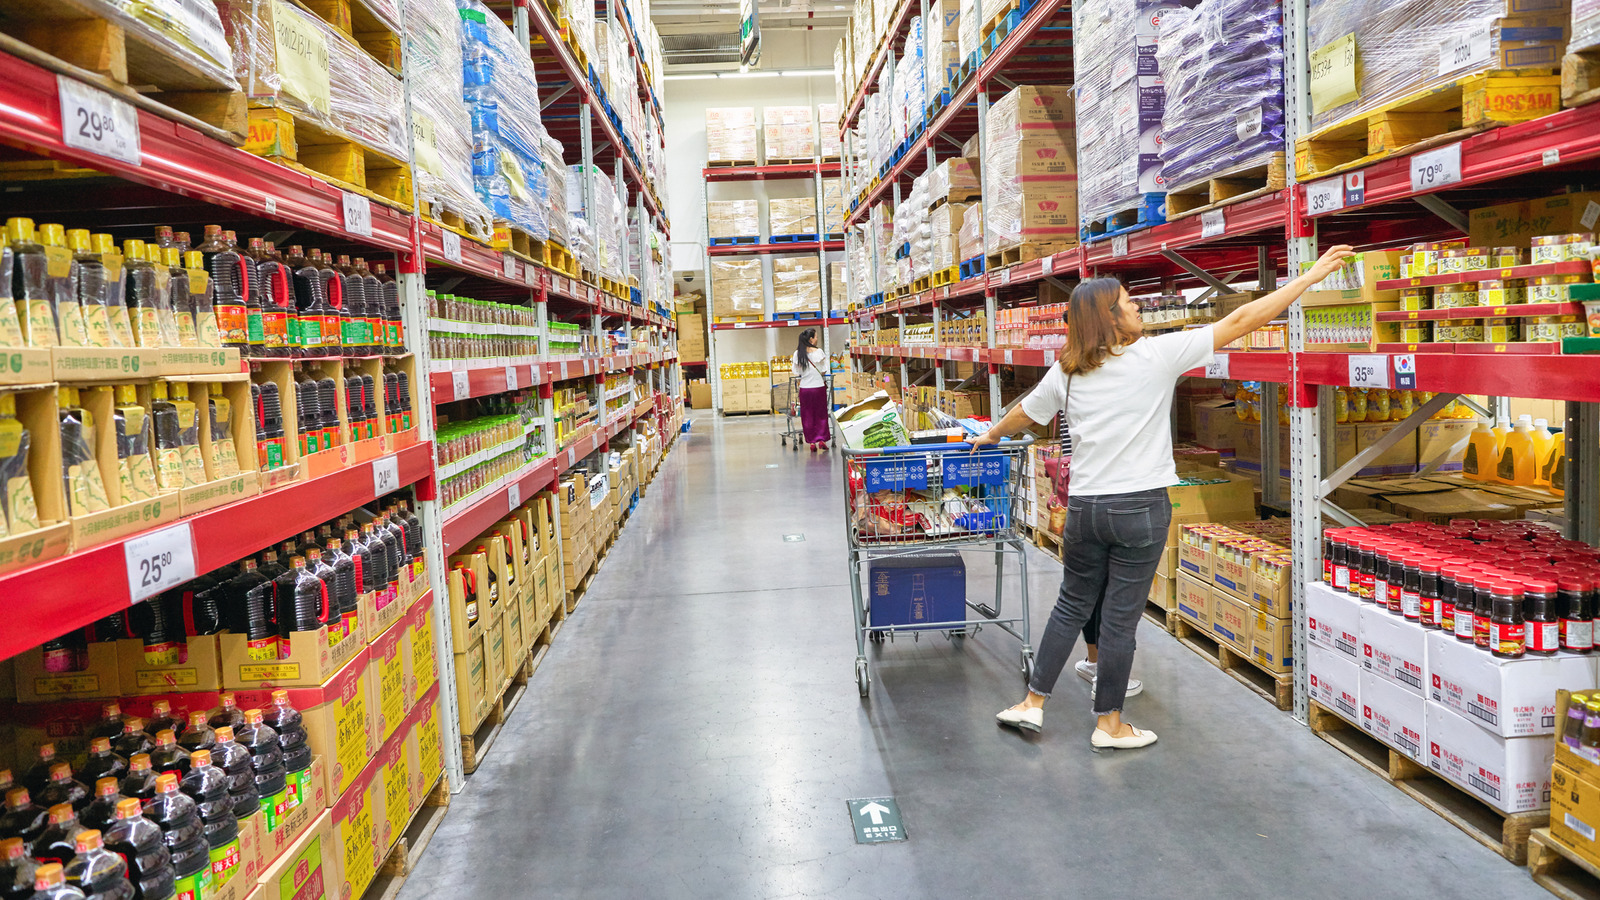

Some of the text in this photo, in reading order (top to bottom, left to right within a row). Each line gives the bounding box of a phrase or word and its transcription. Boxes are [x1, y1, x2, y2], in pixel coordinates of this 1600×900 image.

[1350, 193, 1360, 202] 日本
[140, 551, 172, 588] 2580
[865, 831, 898, 839] EXIT
